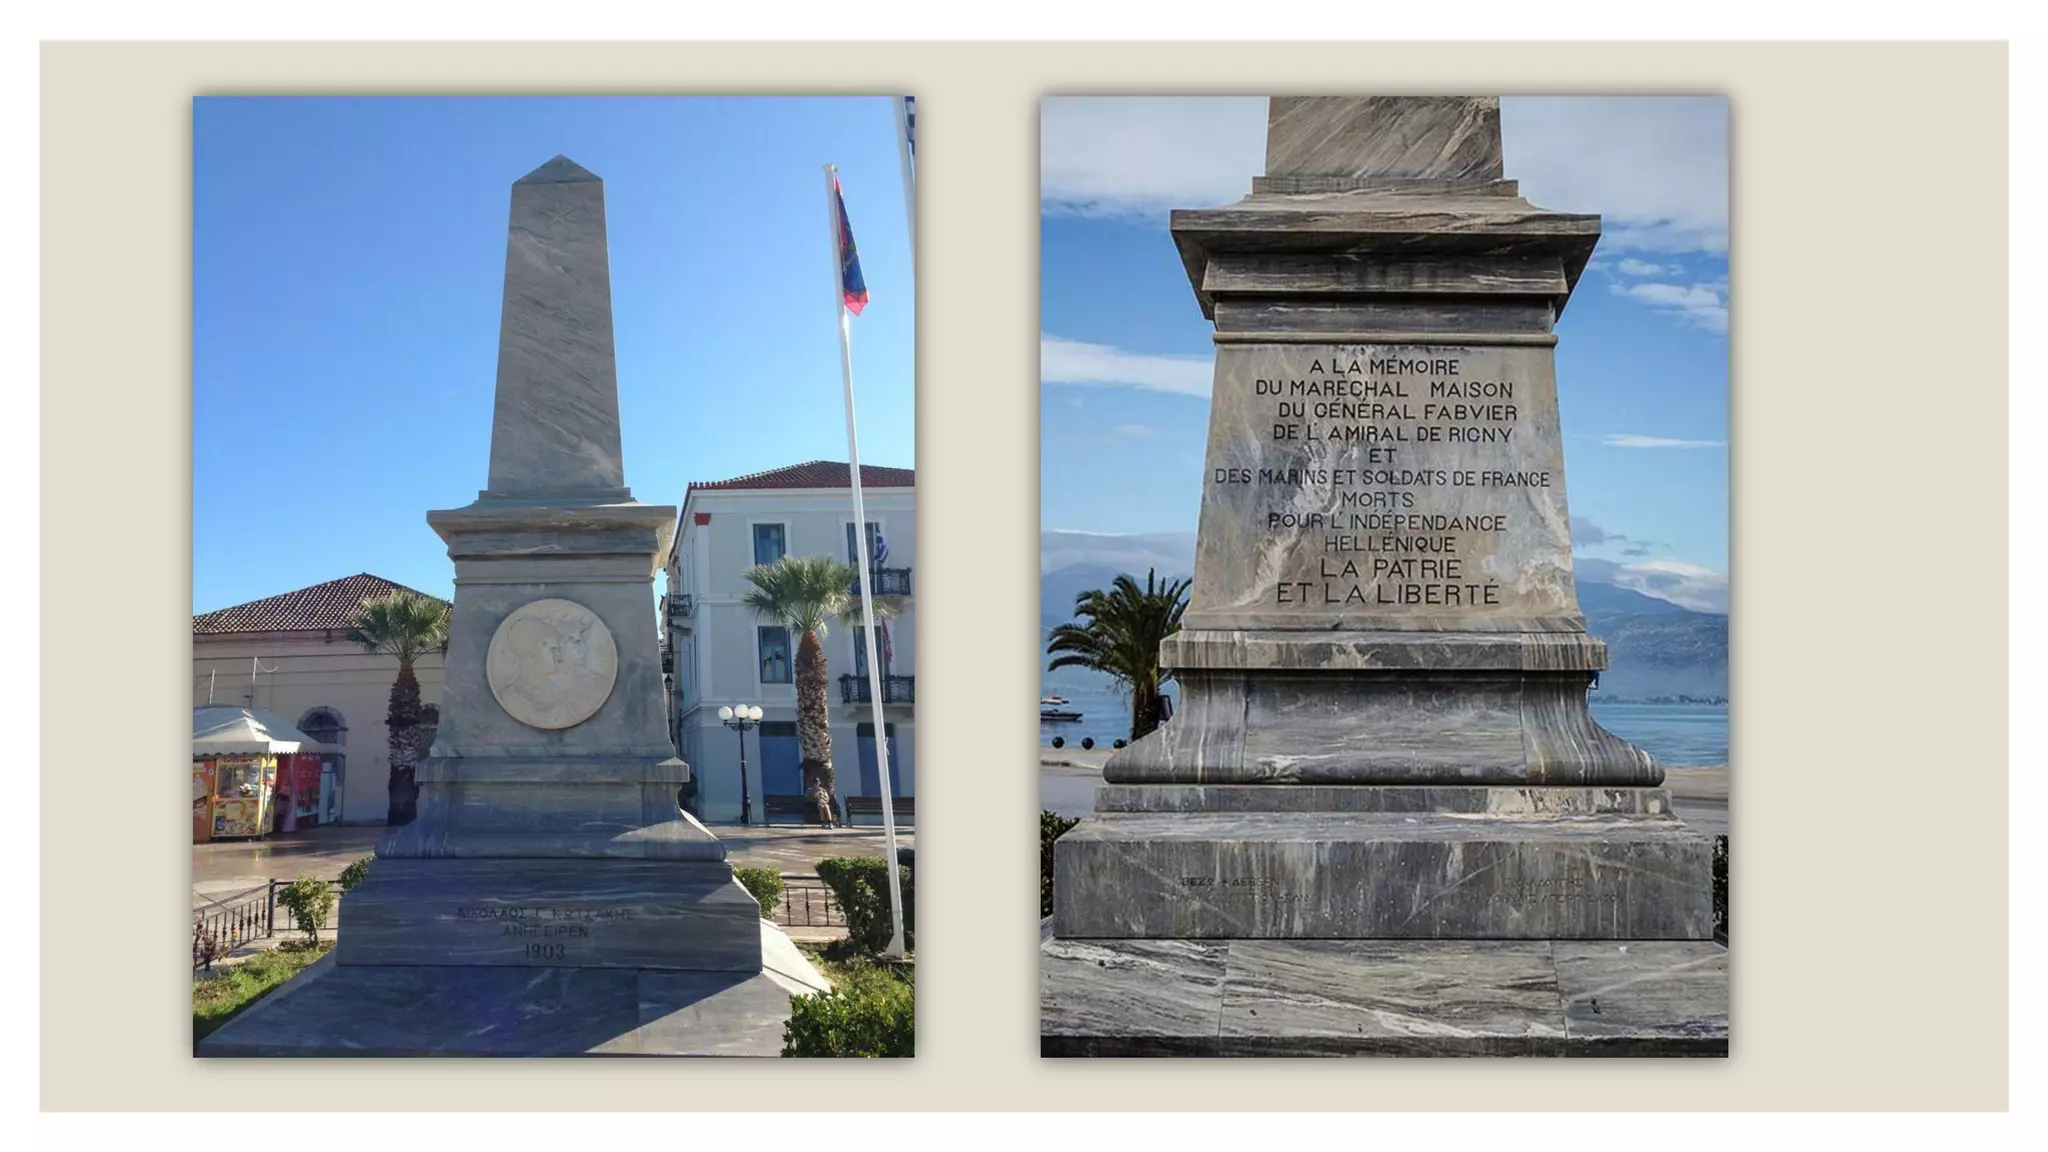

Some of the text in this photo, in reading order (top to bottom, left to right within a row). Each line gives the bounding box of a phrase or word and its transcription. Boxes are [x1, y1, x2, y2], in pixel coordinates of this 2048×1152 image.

[1310, 354, 1459, 375] A LA MÉMOIRE
[1256, 379, 1282, 395] DU
[1431, 381, 1513, 398] MAISON
[1279, 397, 1517, 421] DU GÉNÉRAL FABVIER
[1273, 424, 1299, 440] DE
[1328, 426, 1409, 442] AMIRAL
[1417, 426, 1441, 442] DE
[1449, 426, 1513, 443] RIGNY
[1369, 448, 1397, 463] ET
[1215, 468, 1550, 487] DES MARINS ET SOLDATS DE FRANCE
[1342, 491, 1414, 508] MORTS
[1268, 512, 1323, 529] POUR
[1350, 508, 1507, 531] INDÉPENDANCE
[1325, 531, 1456, 553] HELLÉNIQUE
[1321, 558, 1462, 579] LA PATRIE
[1277, 578, 1500, 605] ET LA LIBERTÉ
[525, 943, 566, 960] 1903
